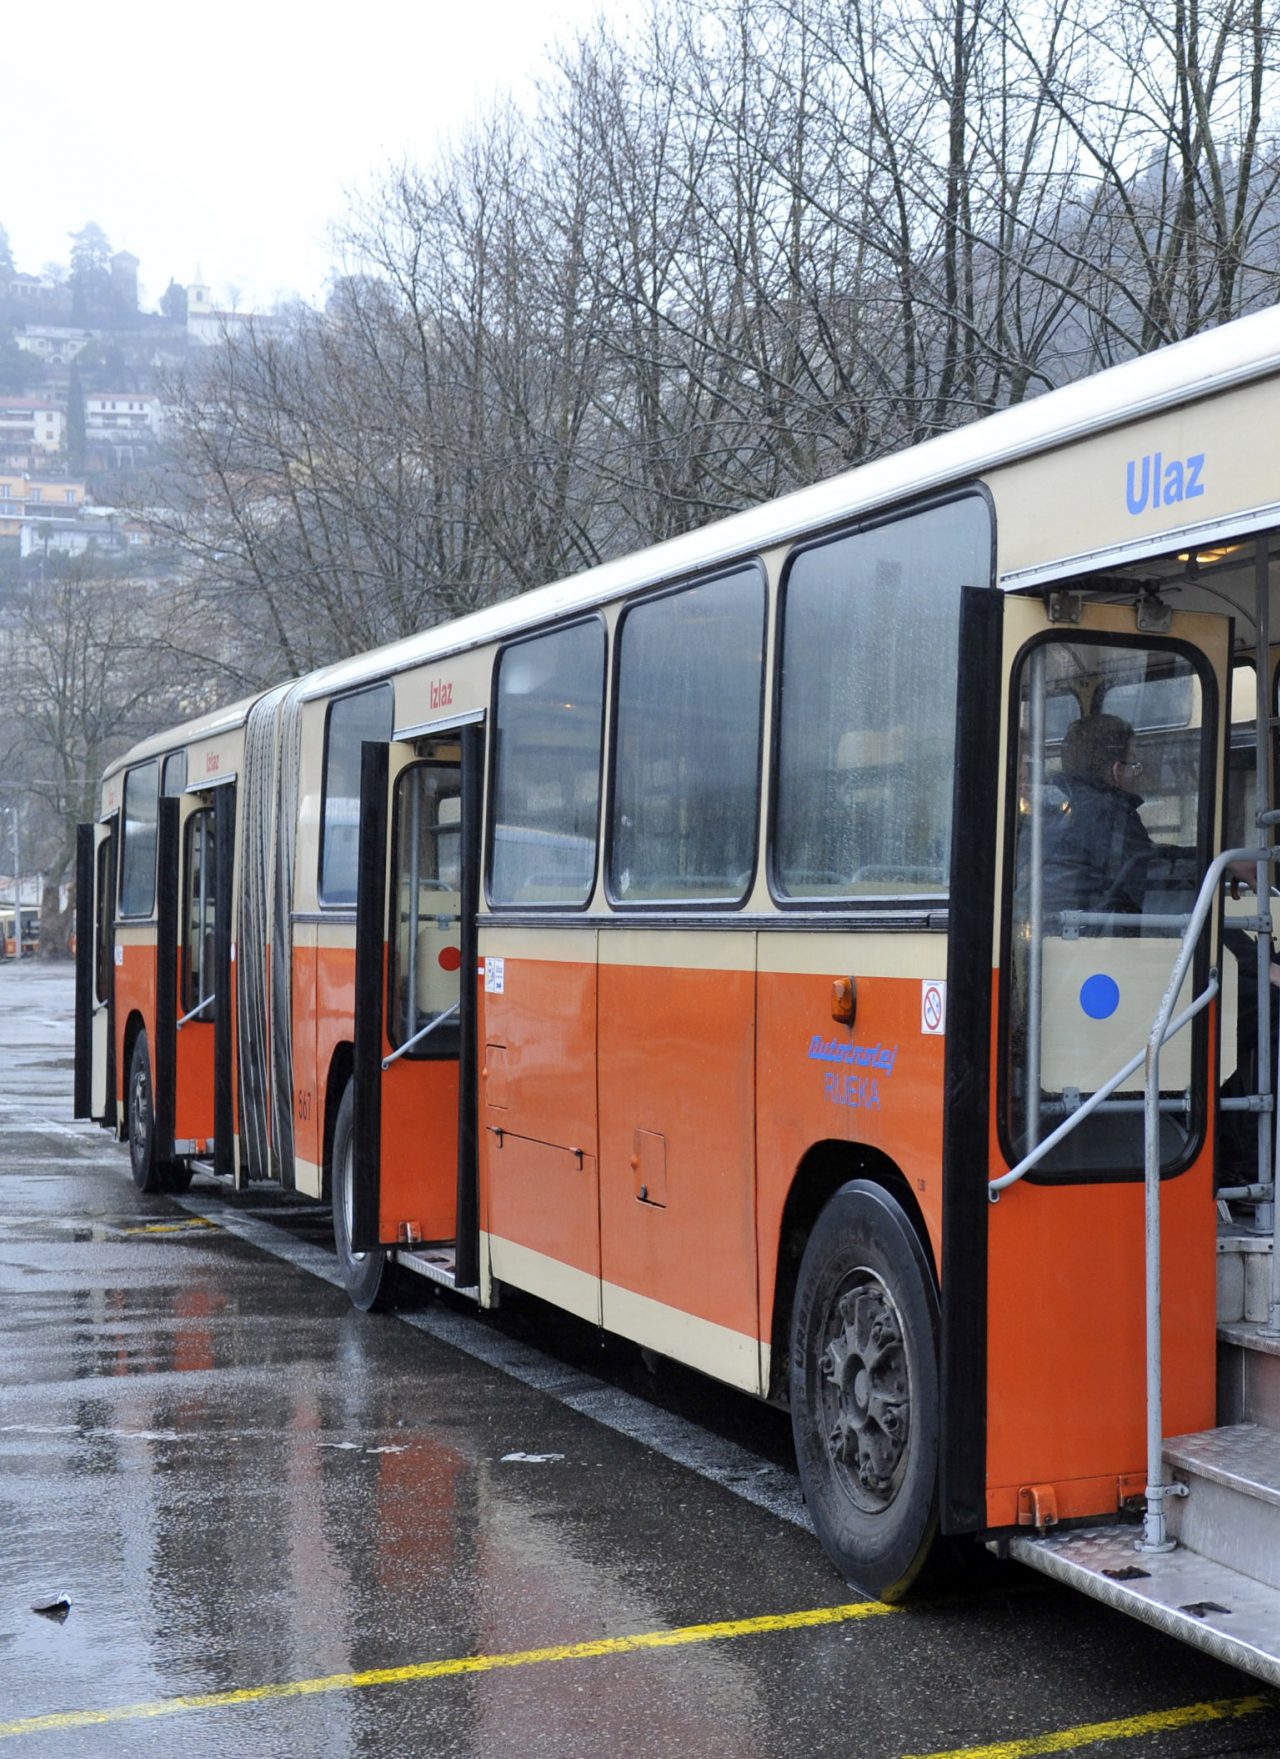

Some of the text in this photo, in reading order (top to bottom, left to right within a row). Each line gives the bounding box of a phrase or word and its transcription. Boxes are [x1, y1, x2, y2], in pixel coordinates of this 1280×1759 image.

[1126, 451, 1205, 515] Ulaz
[430, 678, 453, 710] Izlaz
[825, 1072, 881, 1112] RIJEKA
